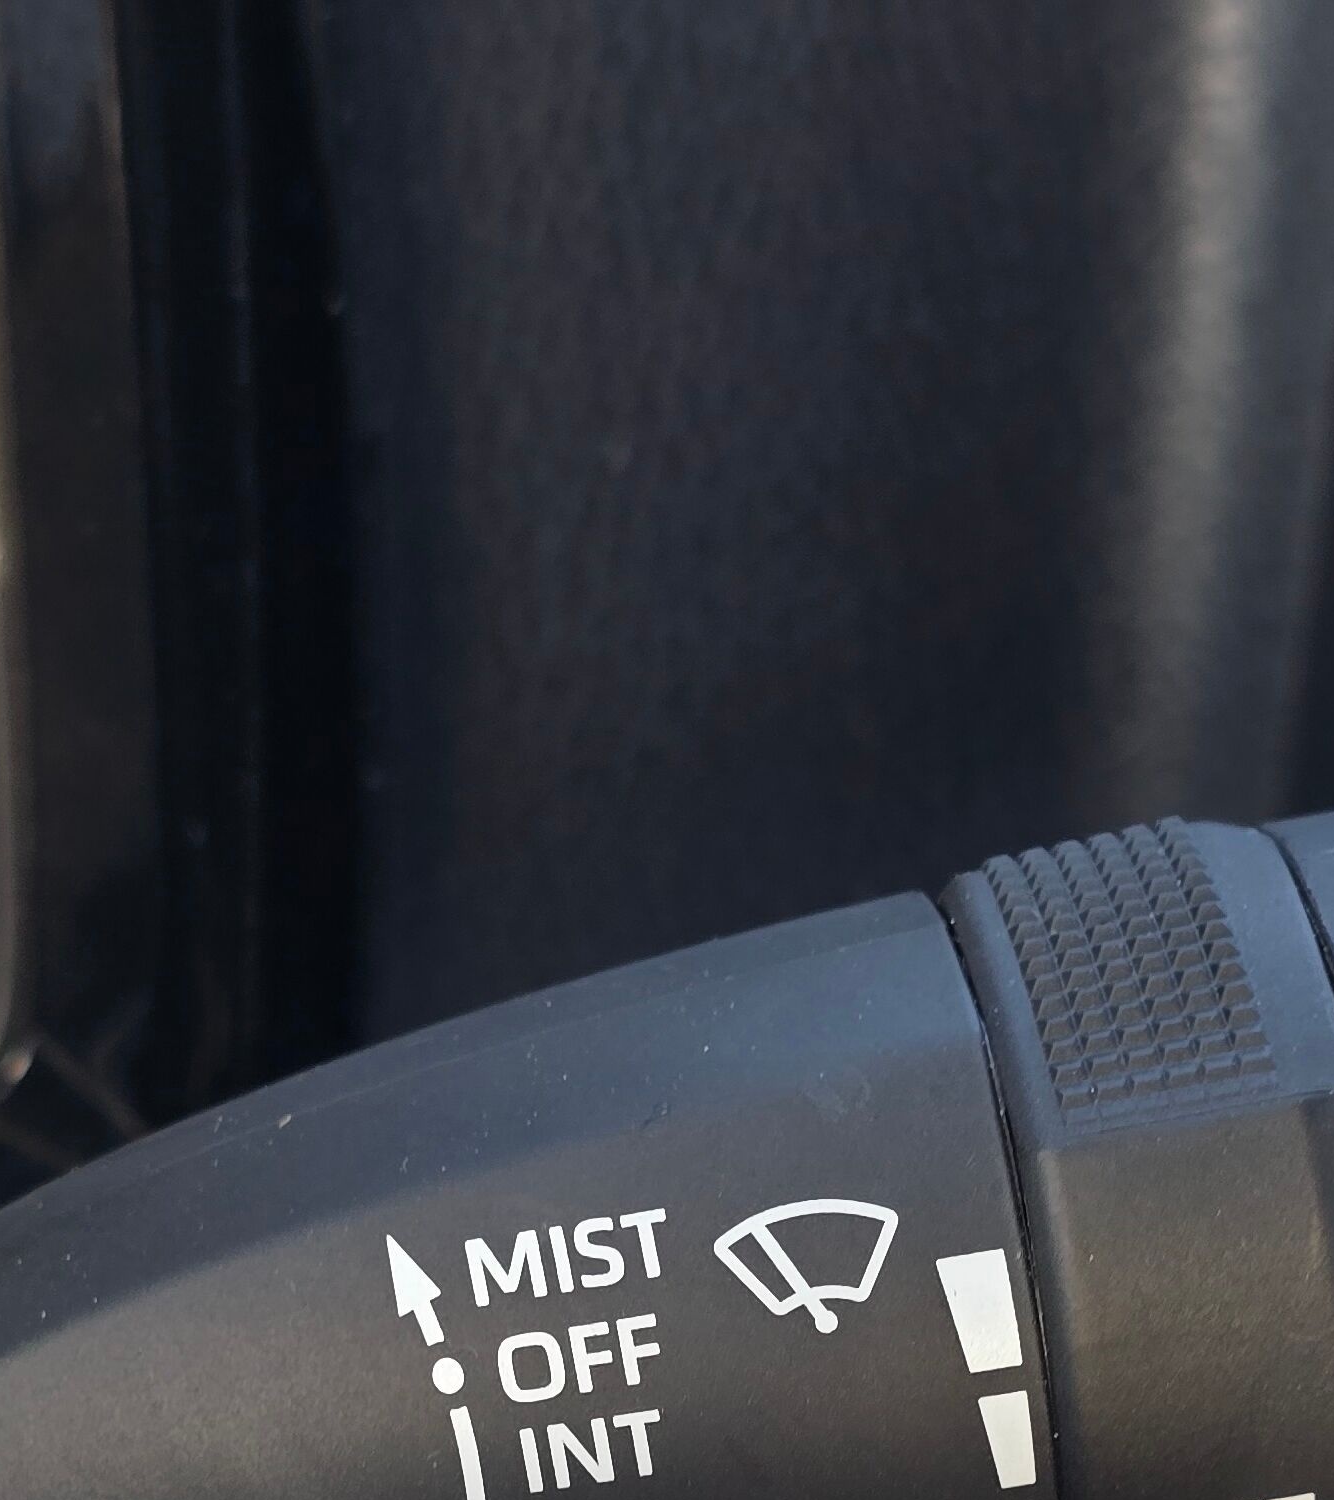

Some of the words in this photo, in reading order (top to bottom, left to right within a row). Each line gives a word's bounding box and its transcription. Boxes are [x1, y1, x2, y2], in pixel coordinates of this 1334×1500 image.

[465, 1207, 666, 1308] MIST
[497, 1312, 663, 1403] OFF
[519, 1408, 663, 1493] INT
